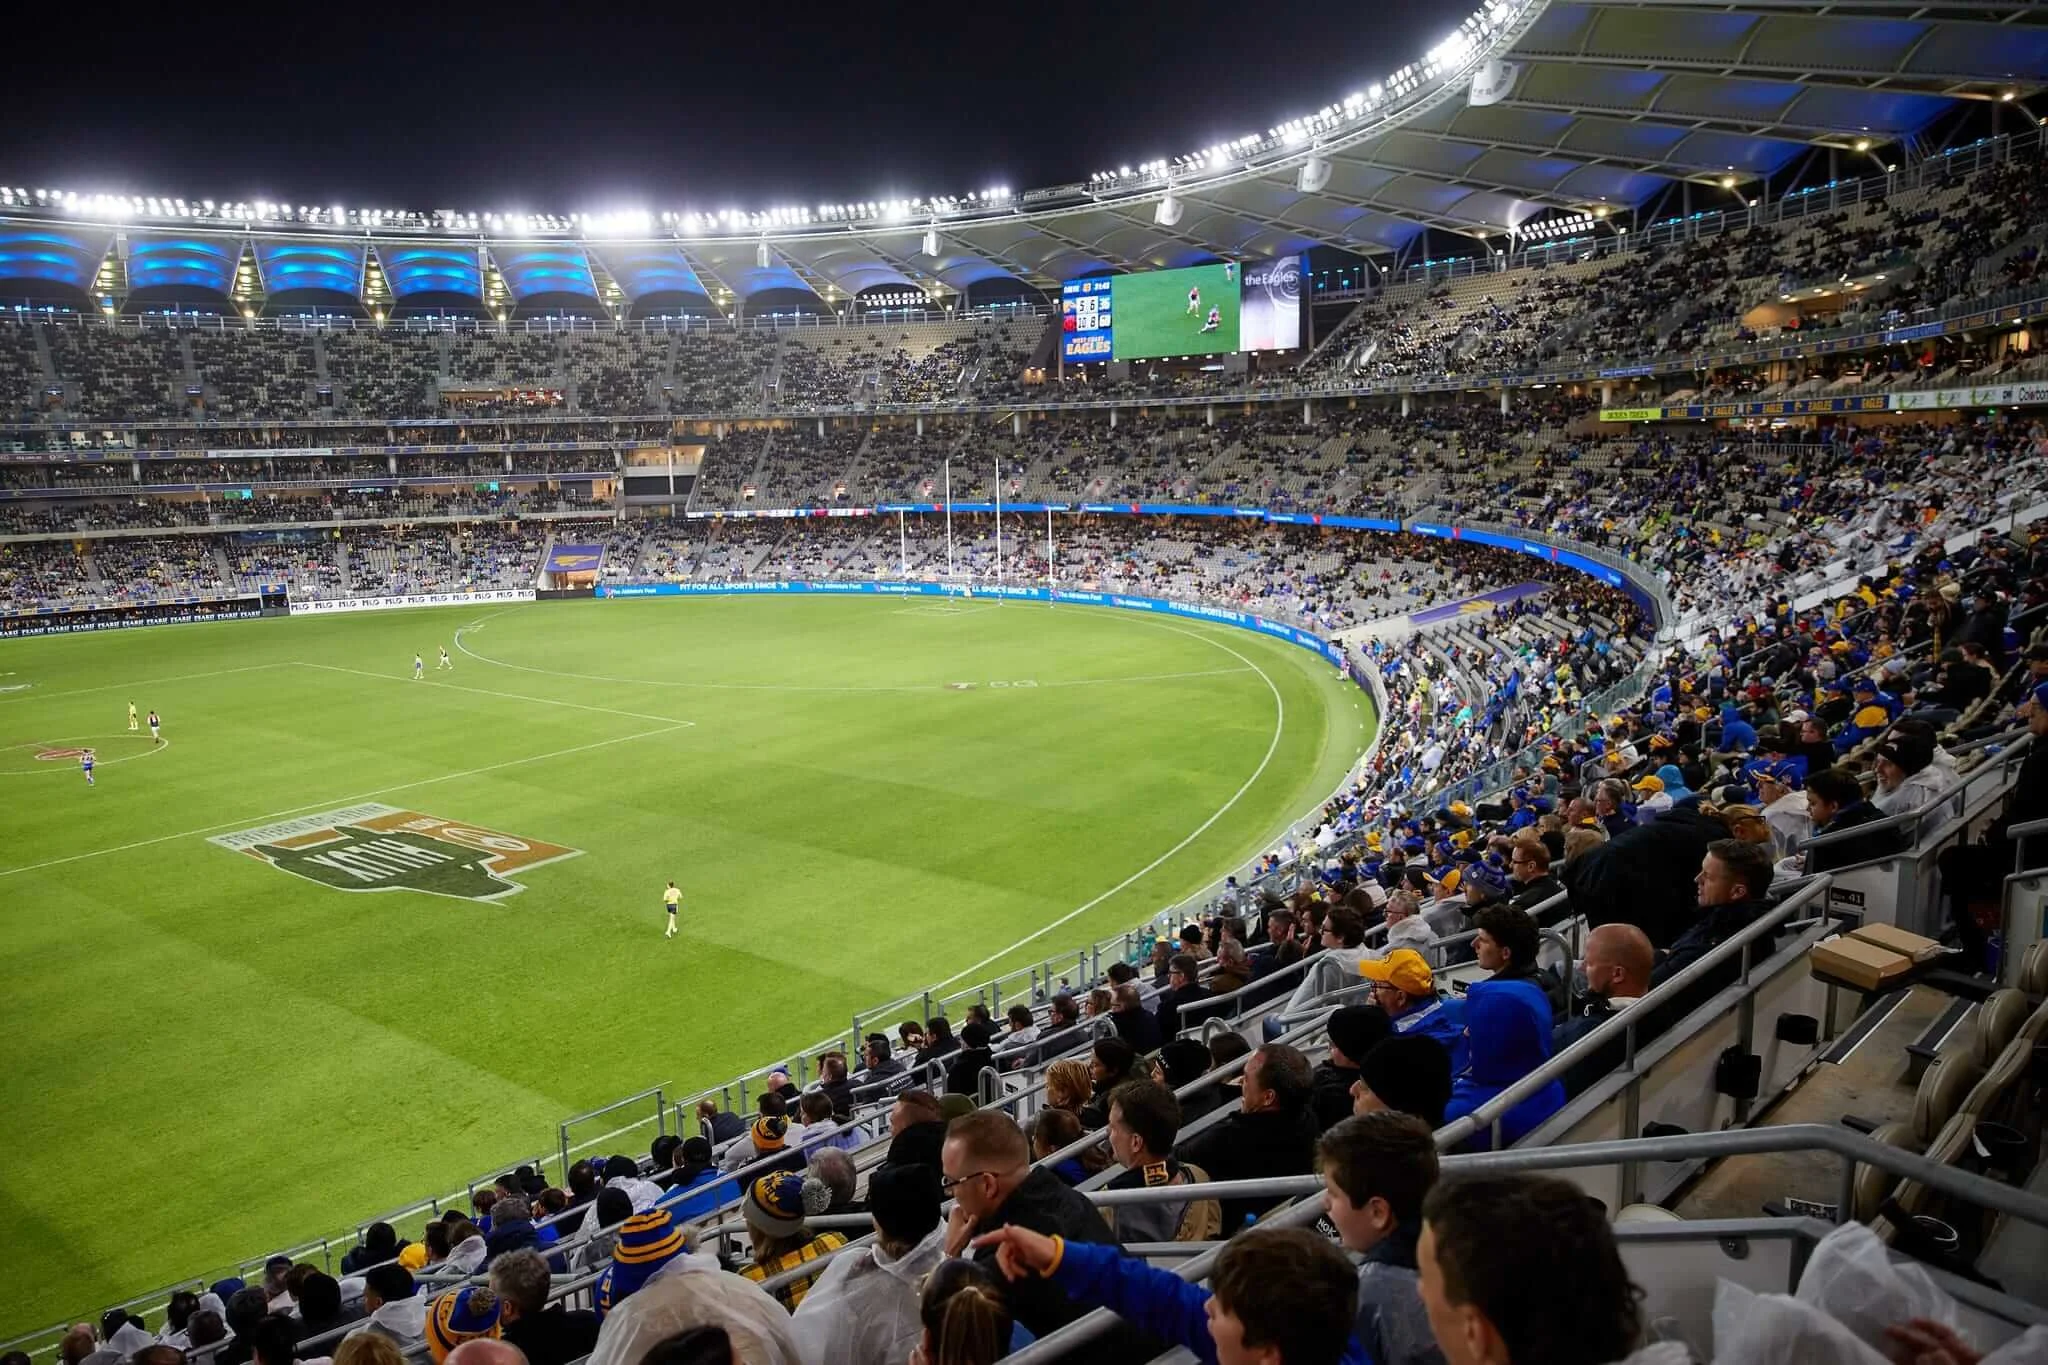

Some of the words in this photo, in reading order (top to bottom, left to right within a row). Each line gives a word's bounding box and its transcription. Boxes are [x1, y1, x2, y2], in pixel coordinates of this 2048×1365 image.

[1244, 273, 1261, 286] the
[1262, 271, 1295, 287] Eagles
[1079, 299, 1085, 312] 5
[1066, 341, 1111, 355] EAGLES
[679, 583, 691, 591] FIT
[692, 583, 707, 591] FOR
[724, 582, 753, 590] SPORTS
[755, 582, 776, 590] SINCE
[303, 838, 455, 882] HILUX
